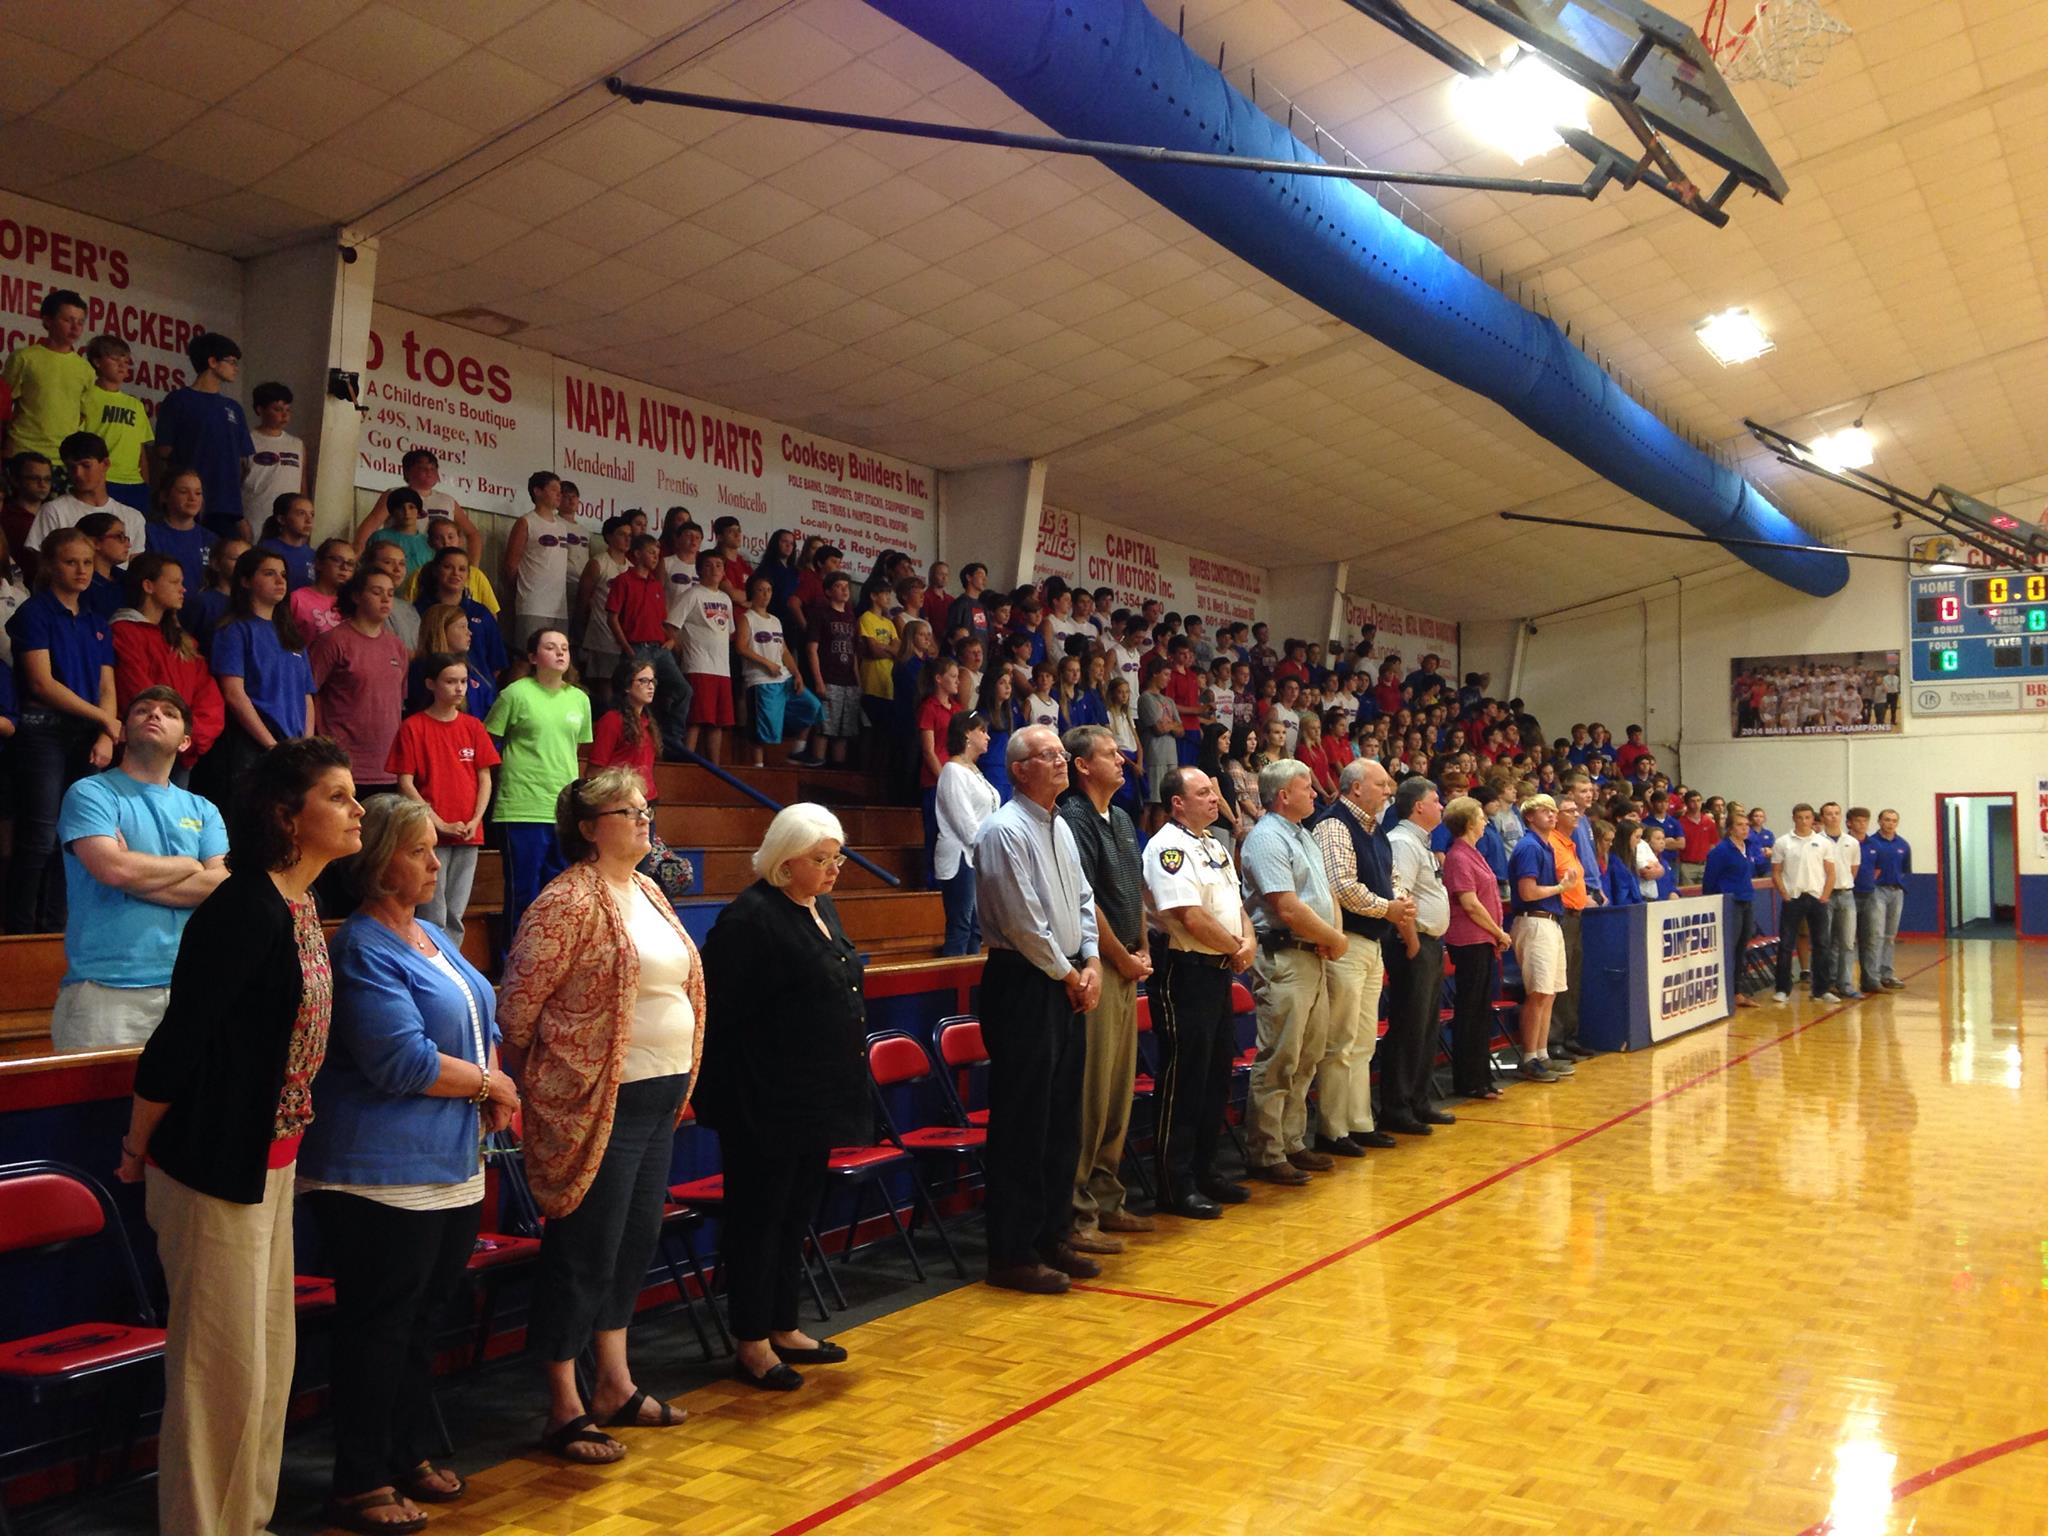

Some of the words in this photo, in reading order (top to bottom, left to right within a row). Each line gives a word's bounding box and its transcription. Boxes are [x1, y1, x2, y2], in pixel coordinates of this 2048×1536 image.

[402, 330, 512, 404] toes
[101, 405, 136, 427] NIKE
[367, 380, 378, 397] A
[383, 384, 456, 415] Children's
[460, 401, 516, 430] Boutique
[368, 429, 392, 449] Go
[416, 415, 470, 445] Magee,
[475, 429, 498, 449] MS
[566, 376, 632, 444] NAPA
[638, 397, 696, 460] AUTO
[701, 415, 763, 478] PARTS
[781, 433, 844, 482] Cooksey
[848, 452, 903, 492] Builders
[906, 469, 929, 500] Inc.
[478, 477, 518, 502] Barry
[564, 447, 635, 483] Mendenhall
[657, 468, 699, 498] Prentiss
[717, 484, 767, 514] Monticello
[800, 515, 833, 532] Locally
[834, 522, 863, 537] Owned
[864, 529, 872, 539] &
[873, 532, 907, 550] Operated
[908, 539, 917, 552] by
[838, 538, 847, 551] &
[1106, 533, 1160, 570] CAPITAL
[1089, 555, 1114, 583] CITY
[1116, 562, 1157, 595] MOTORS
[1159, 574, 1175, 600] Inc.
[1919, 581, 1956, 593] HOME
[1941, 597, 1959, 621] 0
[1991, 615, 2025, 625] PERIOD
[2029, 609, 2046, 631] 0
[1933, 625, 1965, 635] BONUS
[1986, 637, 2022, 647] PLAYER
[1929, 640, 1958, 650] FOULS
[1942, 650, 1958, 671] 0
[1742, 727, 1763, 735] 2014
[1765, 727, 1787, 735] MAIS
[1789, 726, 1803, 734] AA
[1804, 725, 1832, 734] STATE
[1835, 723, 1892, 733] CHAMPIONS
[1662, 911, 1718, 963] SIMPSON
